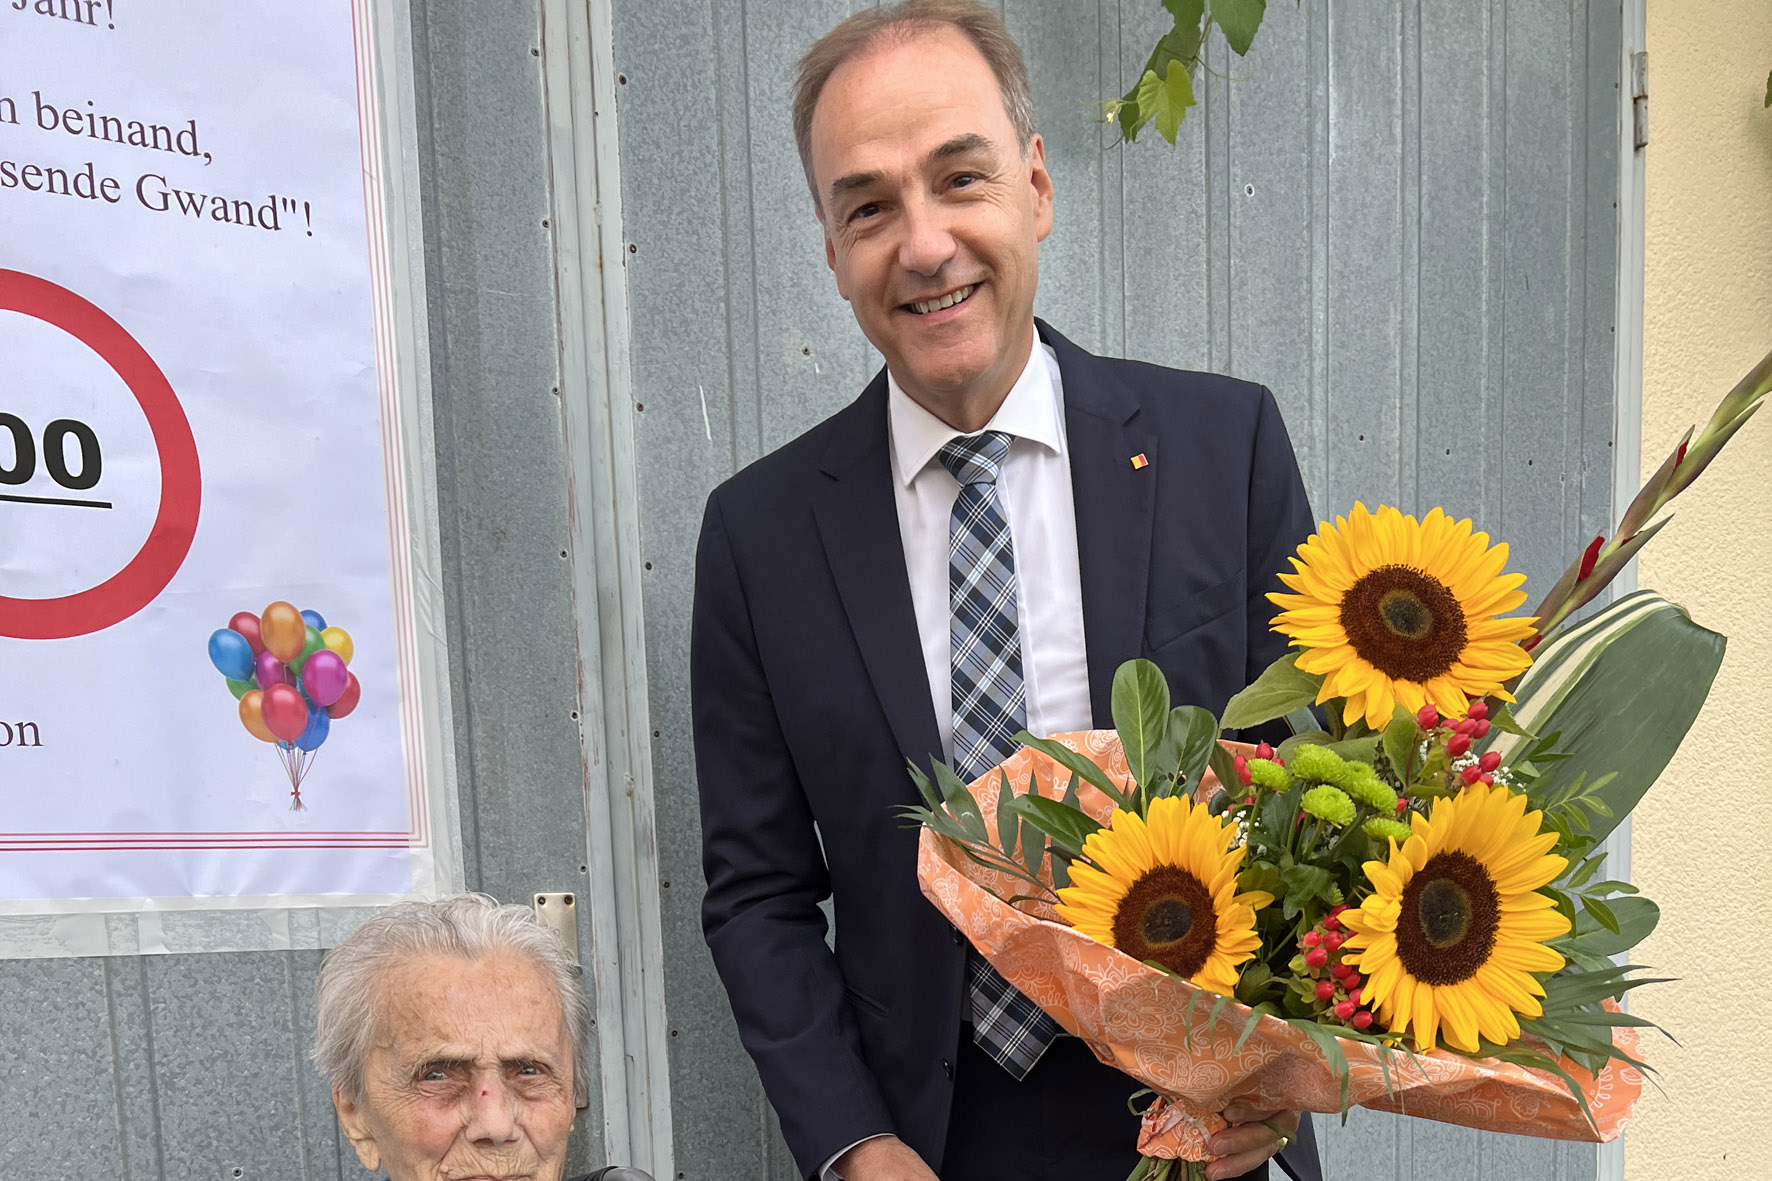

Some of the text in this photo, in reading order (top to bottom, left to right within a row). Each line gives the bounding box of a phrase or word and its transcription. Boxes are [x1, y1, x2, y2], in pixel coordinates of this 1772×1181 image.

[11, 0, 115, 30] ahr!
[31, 90, 212, 166] beinand,
[0, 160, 313, 237] sende Gwand"!
